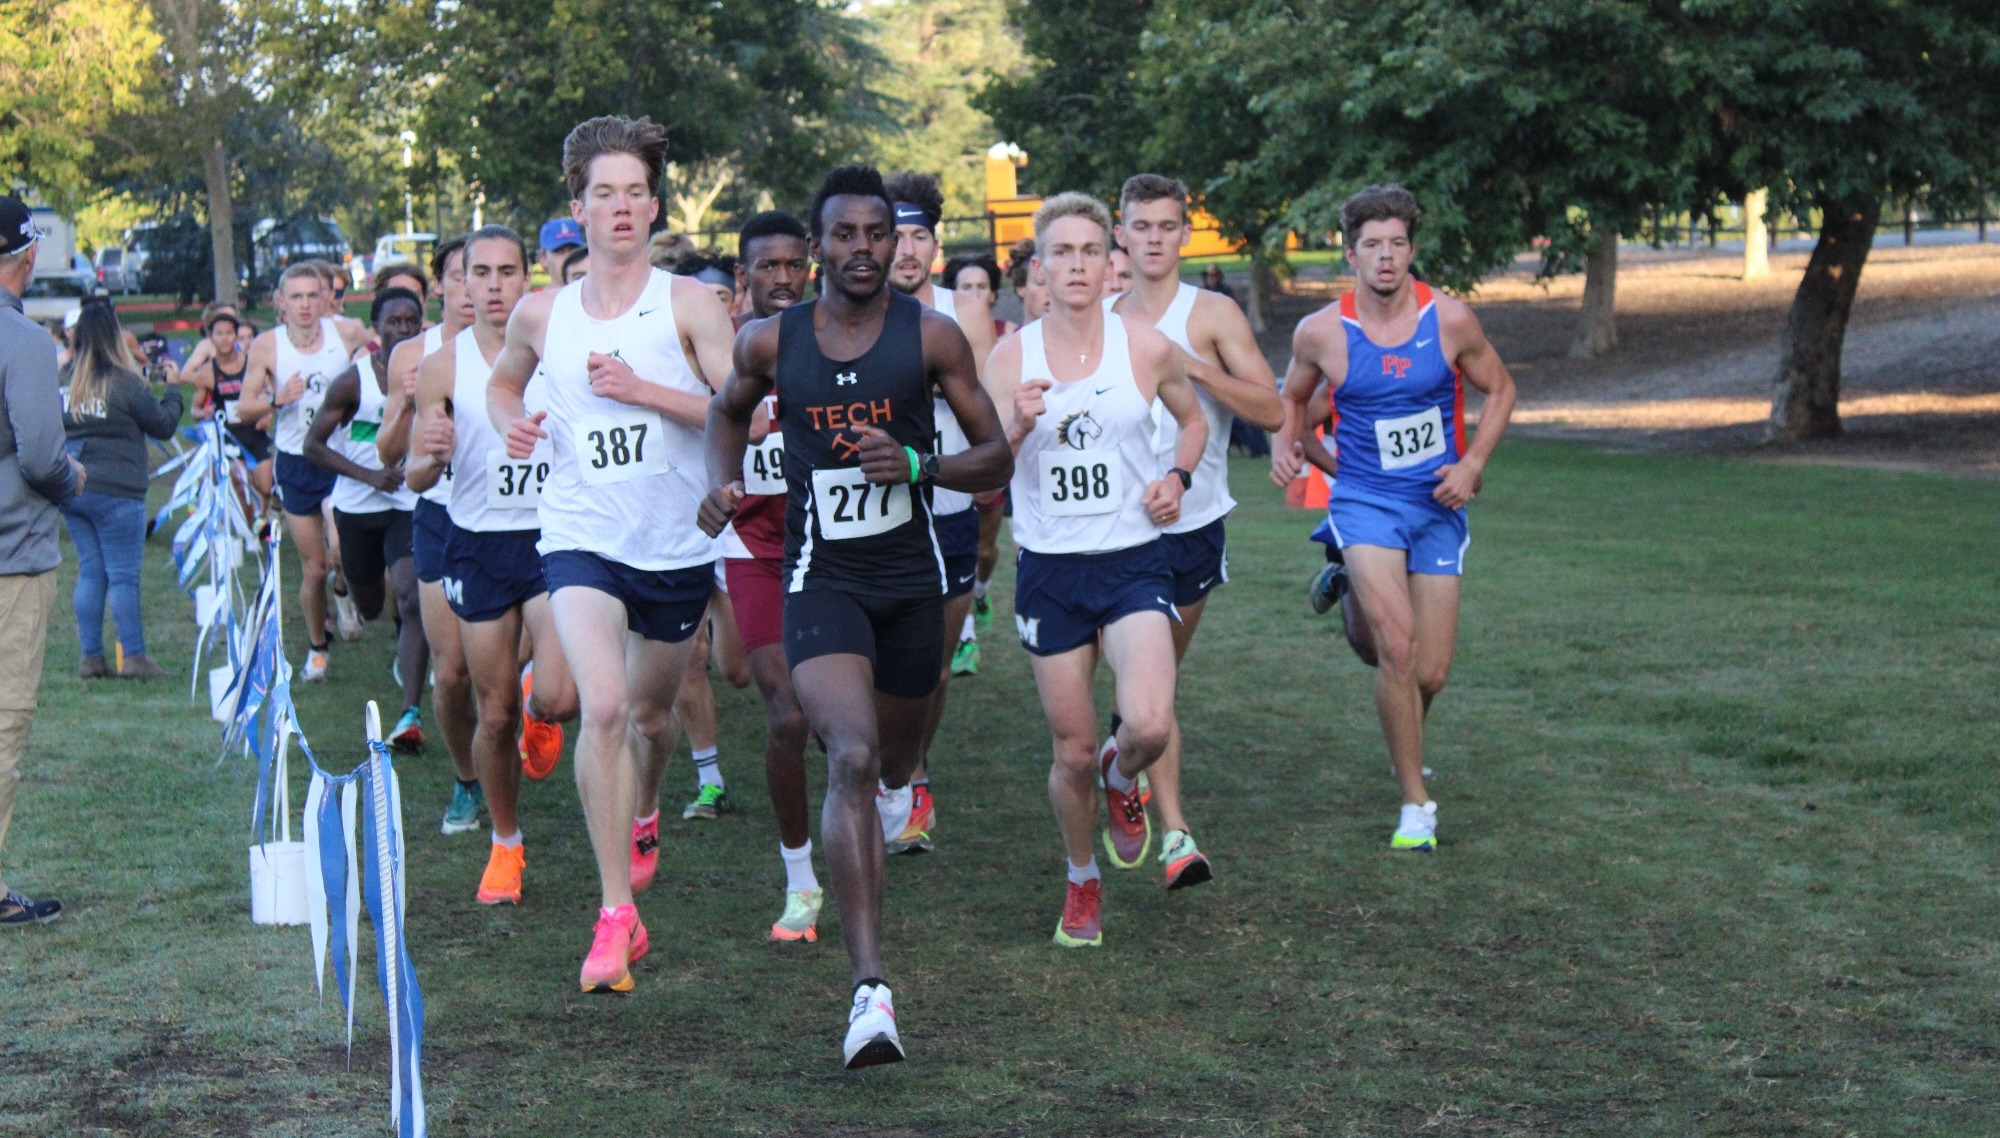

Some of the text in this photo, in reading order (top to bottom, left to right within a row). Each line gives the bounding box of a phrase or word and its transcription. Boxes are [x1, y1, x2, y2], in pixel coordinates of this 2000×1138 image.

[1382, 354, 1412, 378] PP
[806, 399, 892, 430] TECH
[587, 423, 648, 470] 387
[1388, 422, 1436, 458] 332
[499, 463, 550, 496] 379
[753, 447, 784, 481] 49
[1051, 463, 1110, 501] 398
[829, 482, 893, 522] 277
[442, 576, 464, 605] M
[1015, 614, 1041, 648] M
